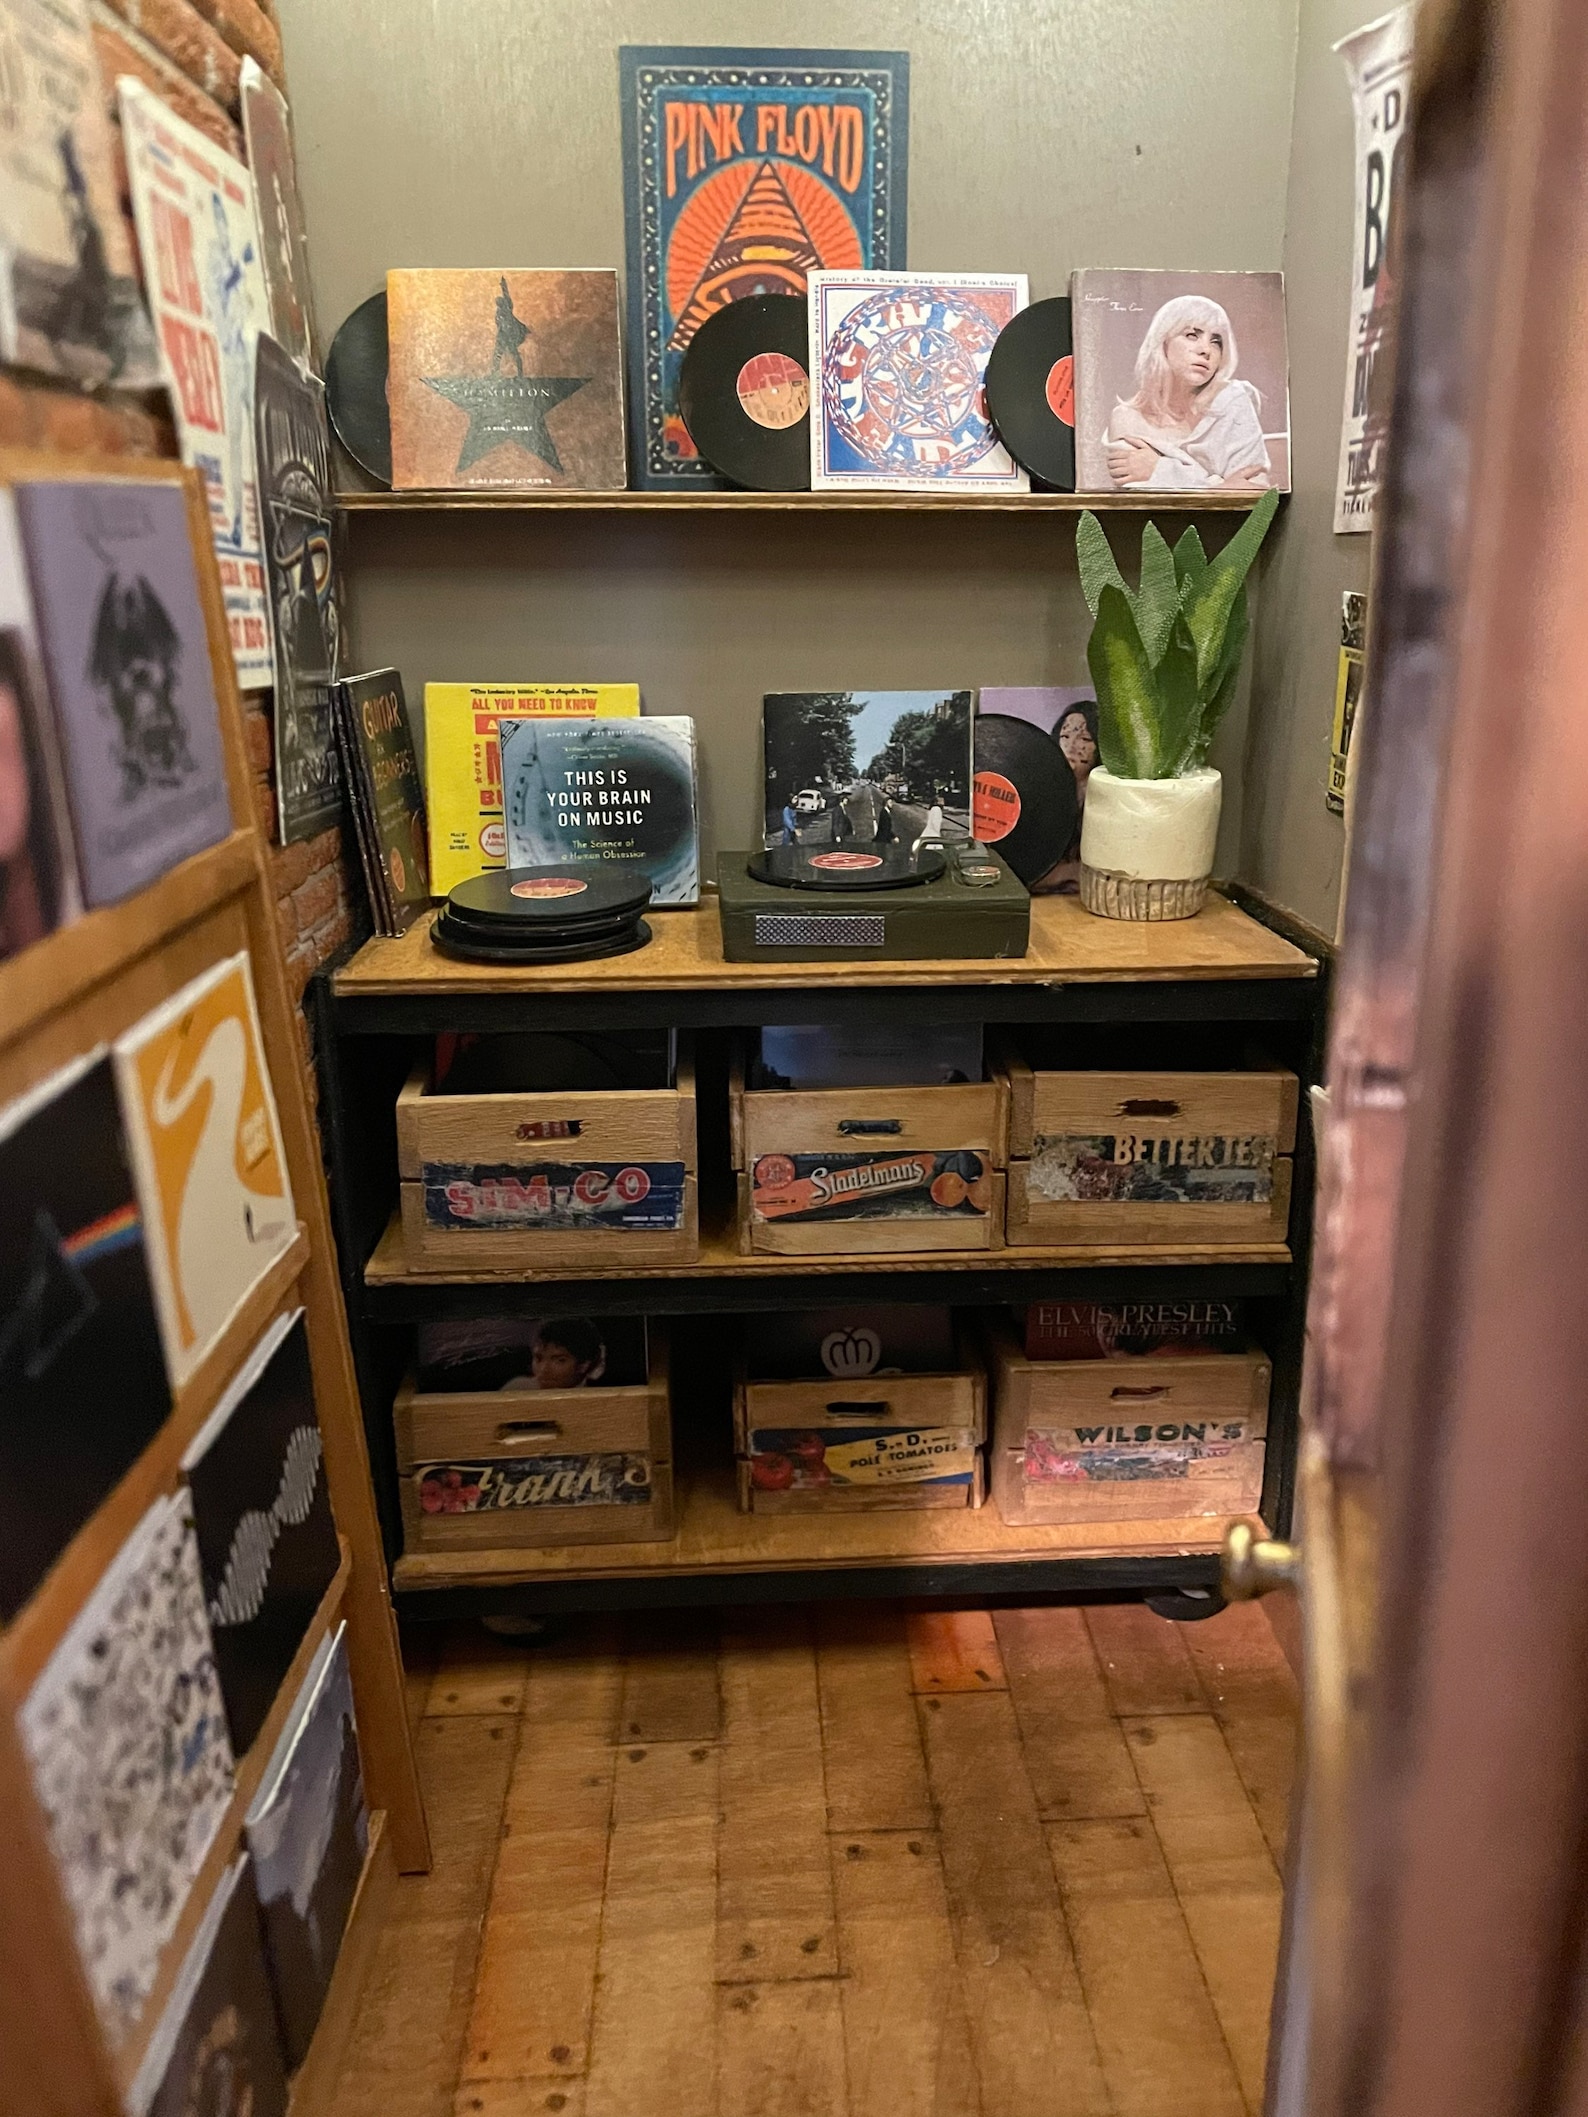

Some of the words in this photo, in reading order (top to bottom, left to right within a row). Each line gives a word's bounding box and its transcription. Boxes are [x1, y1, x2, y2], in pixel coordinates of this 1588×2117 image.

[664, 101, 745, 199] PINK
[756, 103, 864, 195] FLOYD
[472, 697, 491, 710] ALL
[494, 697, 515, 711] YOU
[518, 697, 546, 711] NEED
[549, 697, 562, 711] TO
[565, 697, 597, 711] KNOW
[362, 690, 403, 741] GUITAR
[564, 770, 605, 786] THIS
[610, 769, 628, 785] IS
[546, 791, 593, 807] YOUR
[599, 789, 651, 805] BRAIN
[558, 812, 581, 827] ON
[586, 809, 644, 826] MUSIC
[572, 839, 588, 849] The
[590, 839, 622, 849] Science
[625, 837, 635, 848] of
[569, 851, 600, 860] Human
[602, 849, 646, 860] Obsession
[1038, 1305, 1113, 1326] ELVIS
[1122, 1303, 1235, 1324] PRESLEY
[1195, 1322, 1237, 1335] HITS
[1074, 1421, 1243, 1444] WILSON'S
[889, 1442, 958, 1461] TOMATOES
